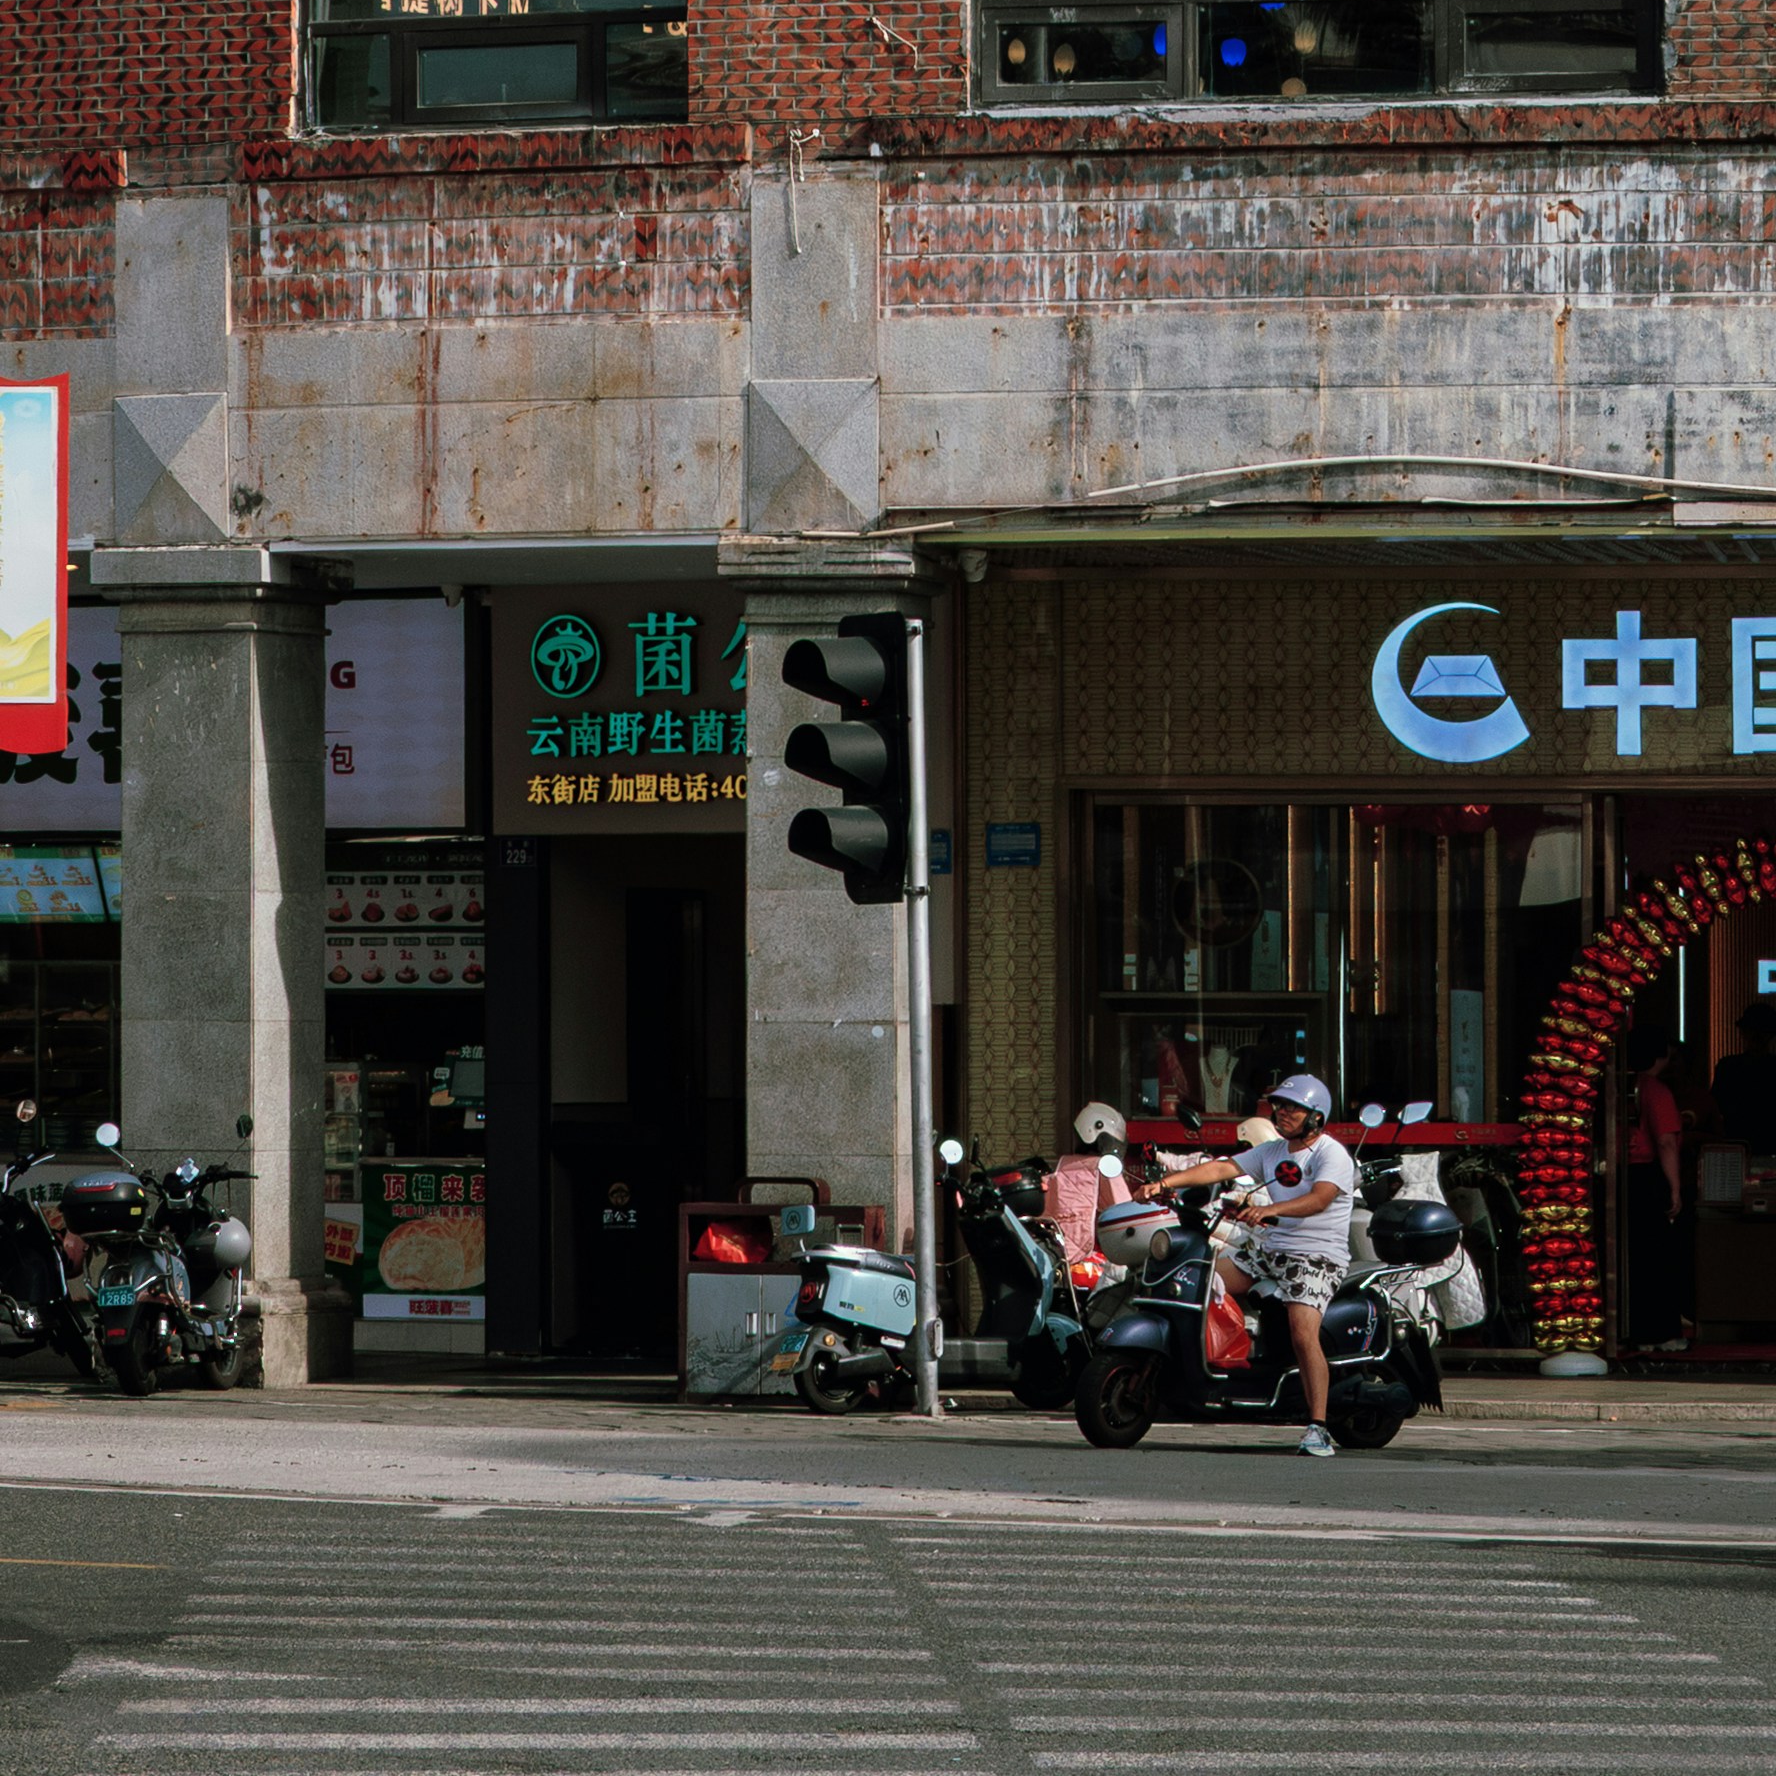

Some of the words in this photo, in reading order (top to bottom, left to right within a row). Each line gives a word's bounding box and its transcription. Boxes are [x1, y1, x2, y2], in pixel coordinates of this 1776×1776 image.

[527, 773, 600, 805] 东街店
[506, 849, 527, 864] 229
